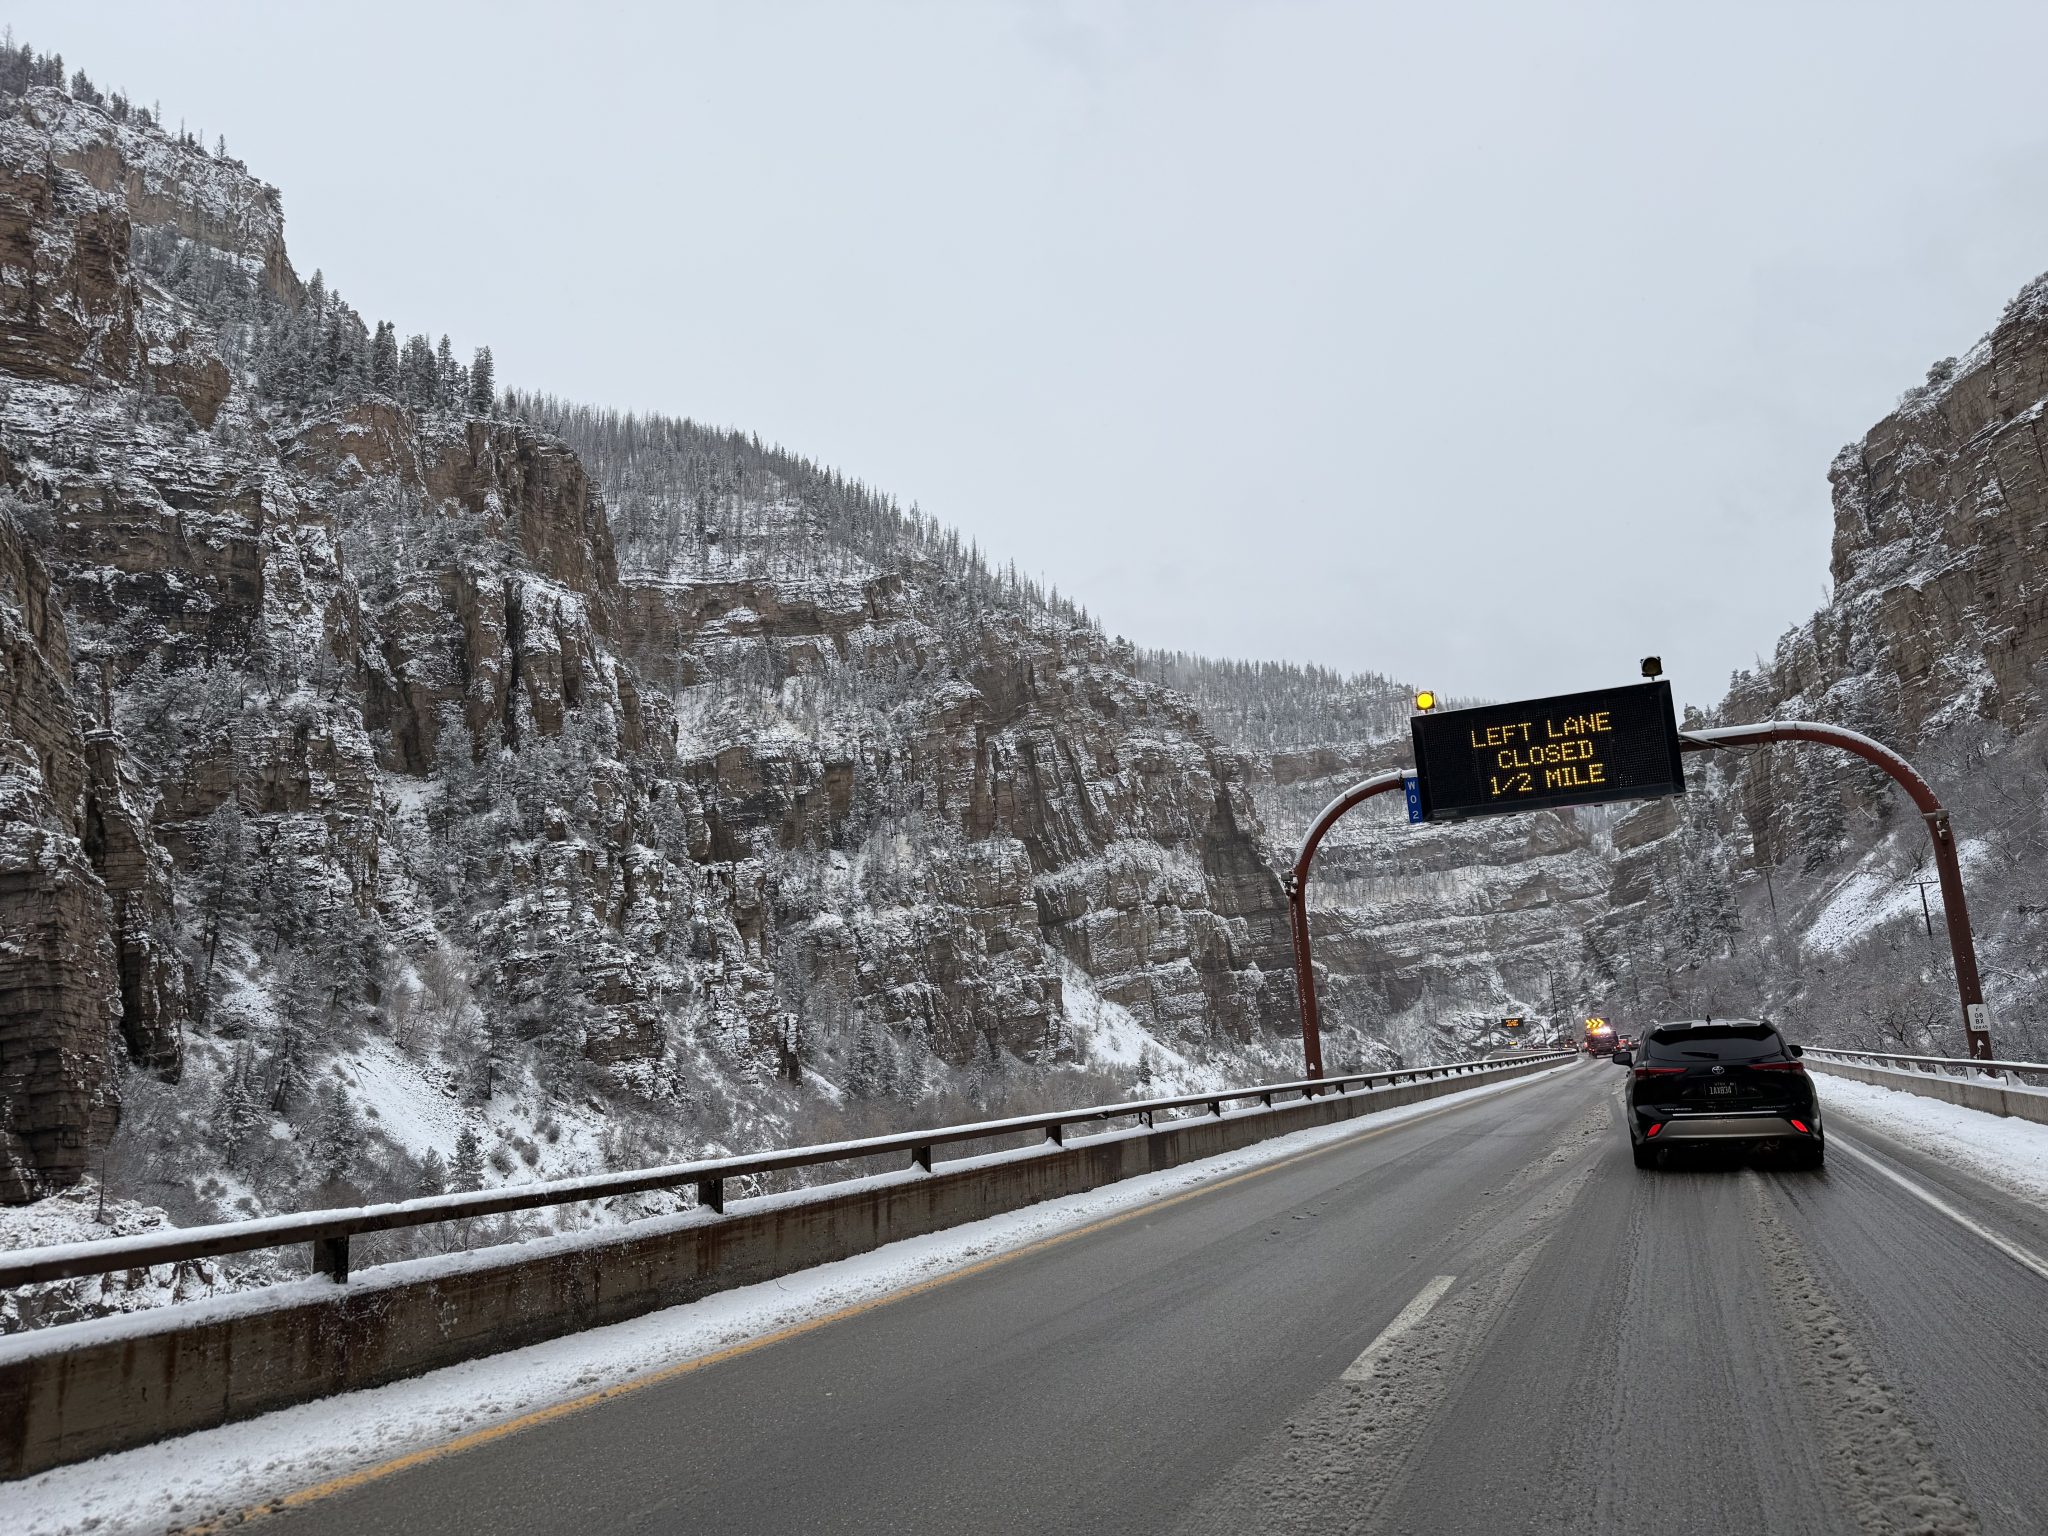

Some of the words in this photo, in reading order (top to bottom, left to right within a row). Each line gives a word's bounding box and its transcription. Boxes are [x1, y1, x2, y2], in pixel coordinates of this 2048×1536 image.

[1471, 722, 1532, 748] LEFT
[1547, 711, 1612, 738] LANE
[1497, 739, 1594, 769] CLOSED
[1490, 772, 1533, 796] 1/2
[1545, 763, 1606, 788] MILE
